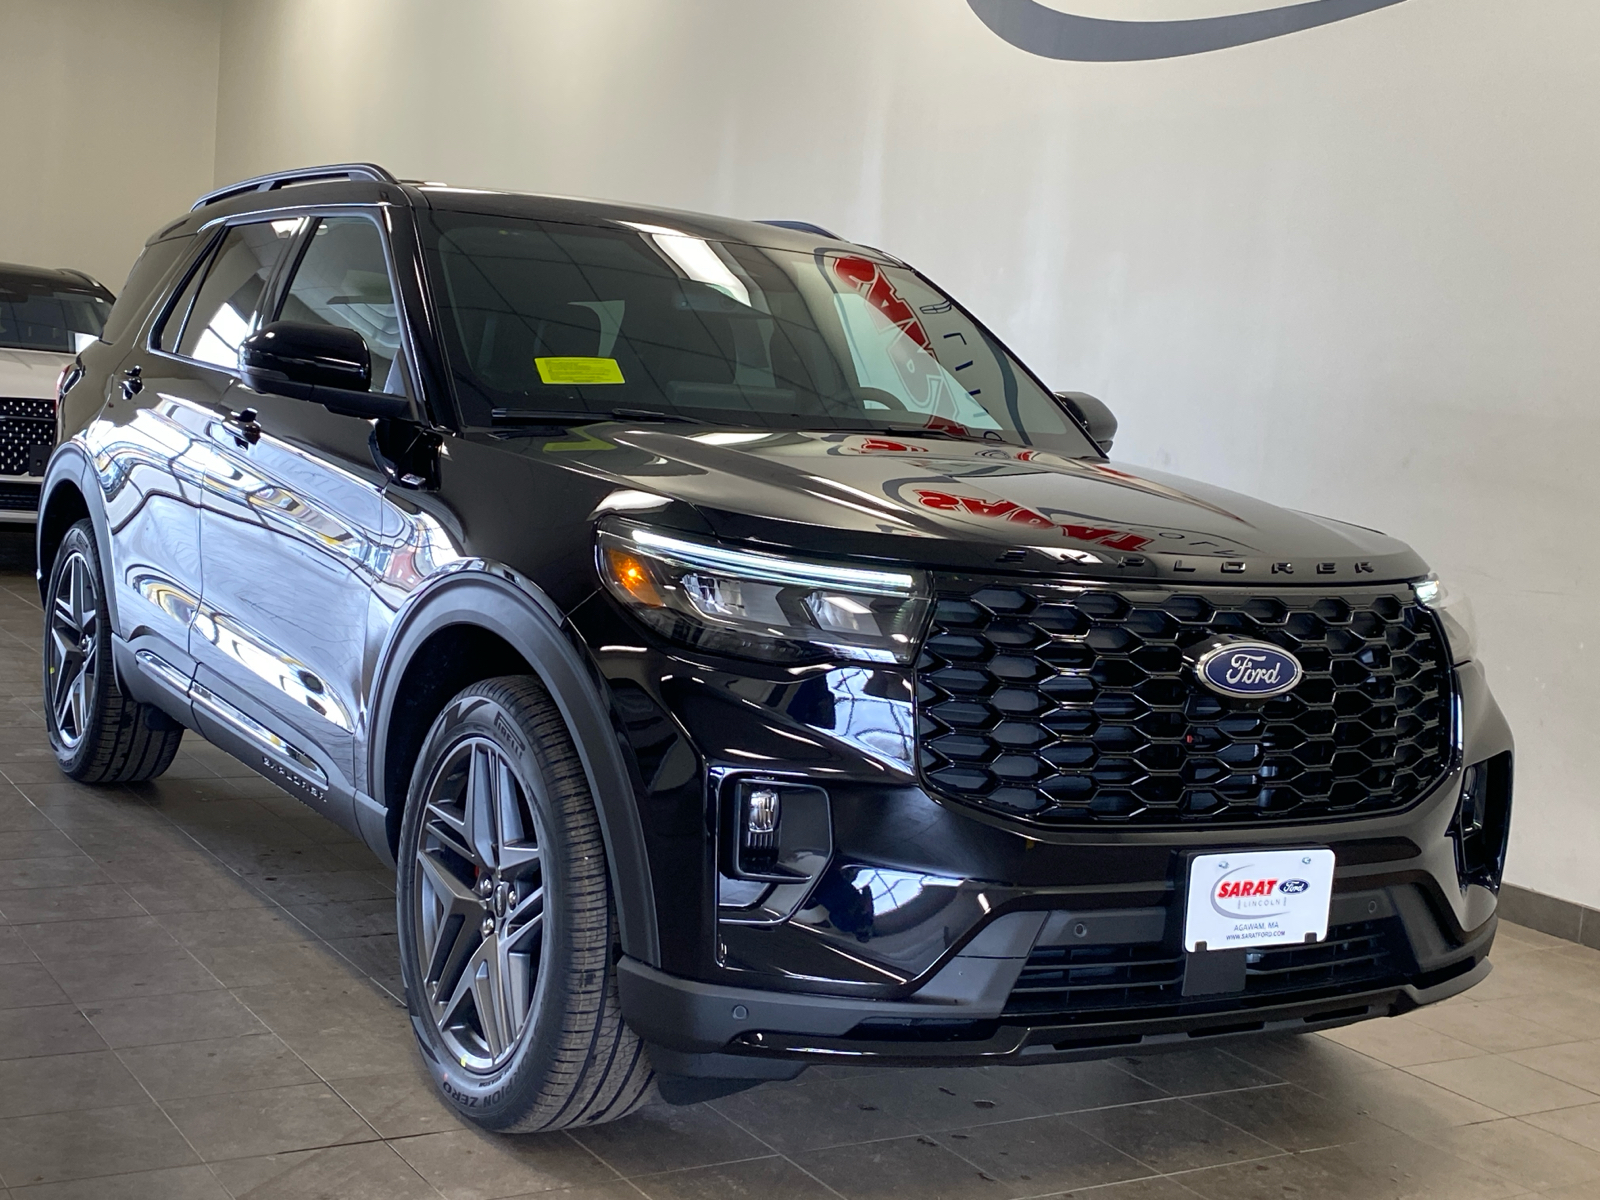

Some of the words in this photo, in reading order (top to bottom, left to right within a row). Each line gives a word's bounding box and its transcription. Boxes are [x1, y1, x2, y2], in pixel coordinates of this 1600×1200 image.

[996, 547, 1375, 575] EXPLORER
[1226, 653, 1281, 684] Ford
[493, 710, 526, 759] PIRELLI
[1217, 879, 1278, 899] SARAT
[1282, 880, 1305, 893] Ford
[1243, 898, 1281, 908] LINCOLN
[1226, 930, 1286, 941] WWW.SARATFORD.COM
[1233, 922, 1265, 932] AGAWAM,
[1267, 921, 1280, 930] MA
[442, 1081, 479, 1108] ZERO
